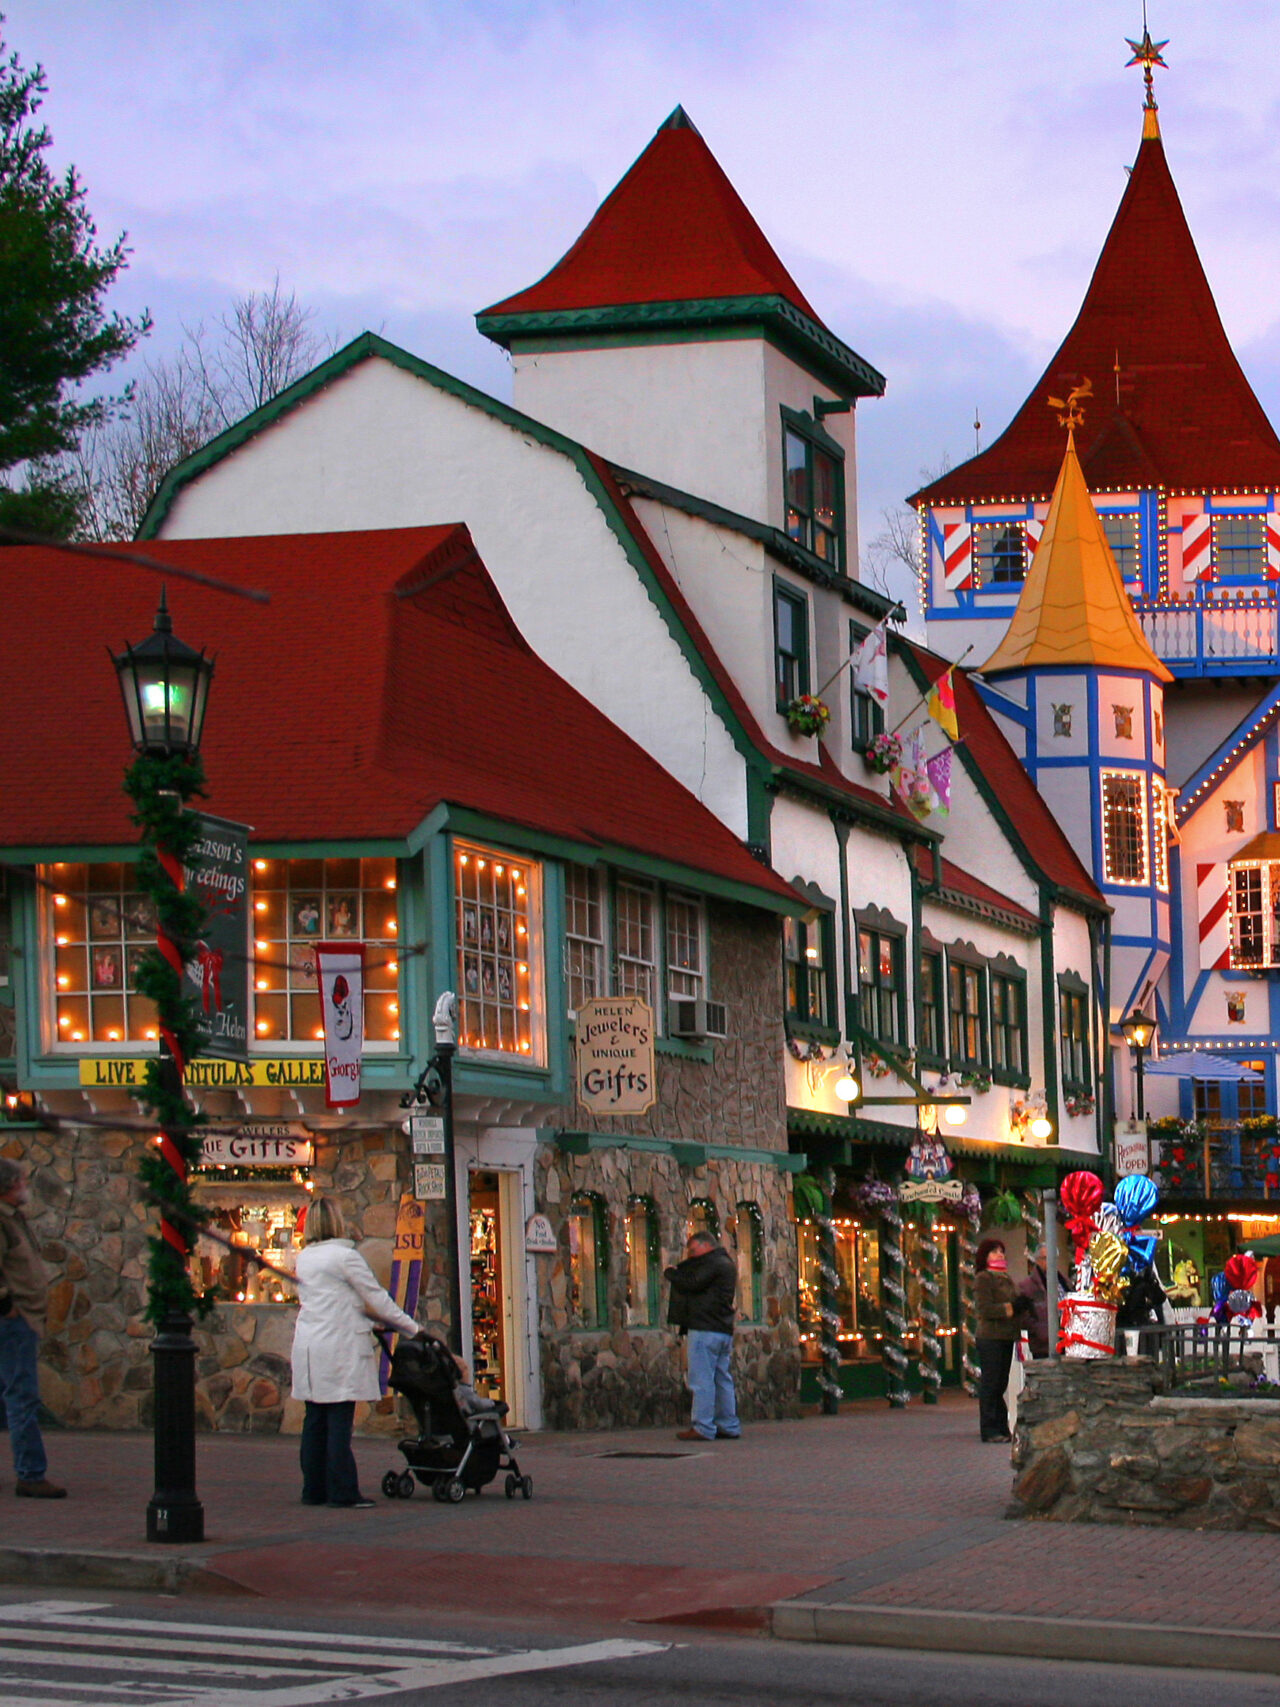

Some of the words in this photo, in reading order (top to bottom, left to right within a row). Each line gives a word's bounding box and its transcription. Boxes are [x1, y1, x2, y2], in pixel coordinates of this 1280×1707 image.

[189, 837, 243, 864] eason's
[184, 864, 245, 901] reetings
[594, 1007, 634, 1016] HELEN
[581, 1017, 648, 1045] Jewelers
[592, 1048, 637, 1058] UNIQUE
[95, 1061, 136, 1083] LIVE
[170, 1061, 255, 1085] ANTULAS
[585, 1064, 648, 1103] Gifts
[1125, 1159, 1147, 1169] OPEN
[396, 1234, 423, 1249] LSU
